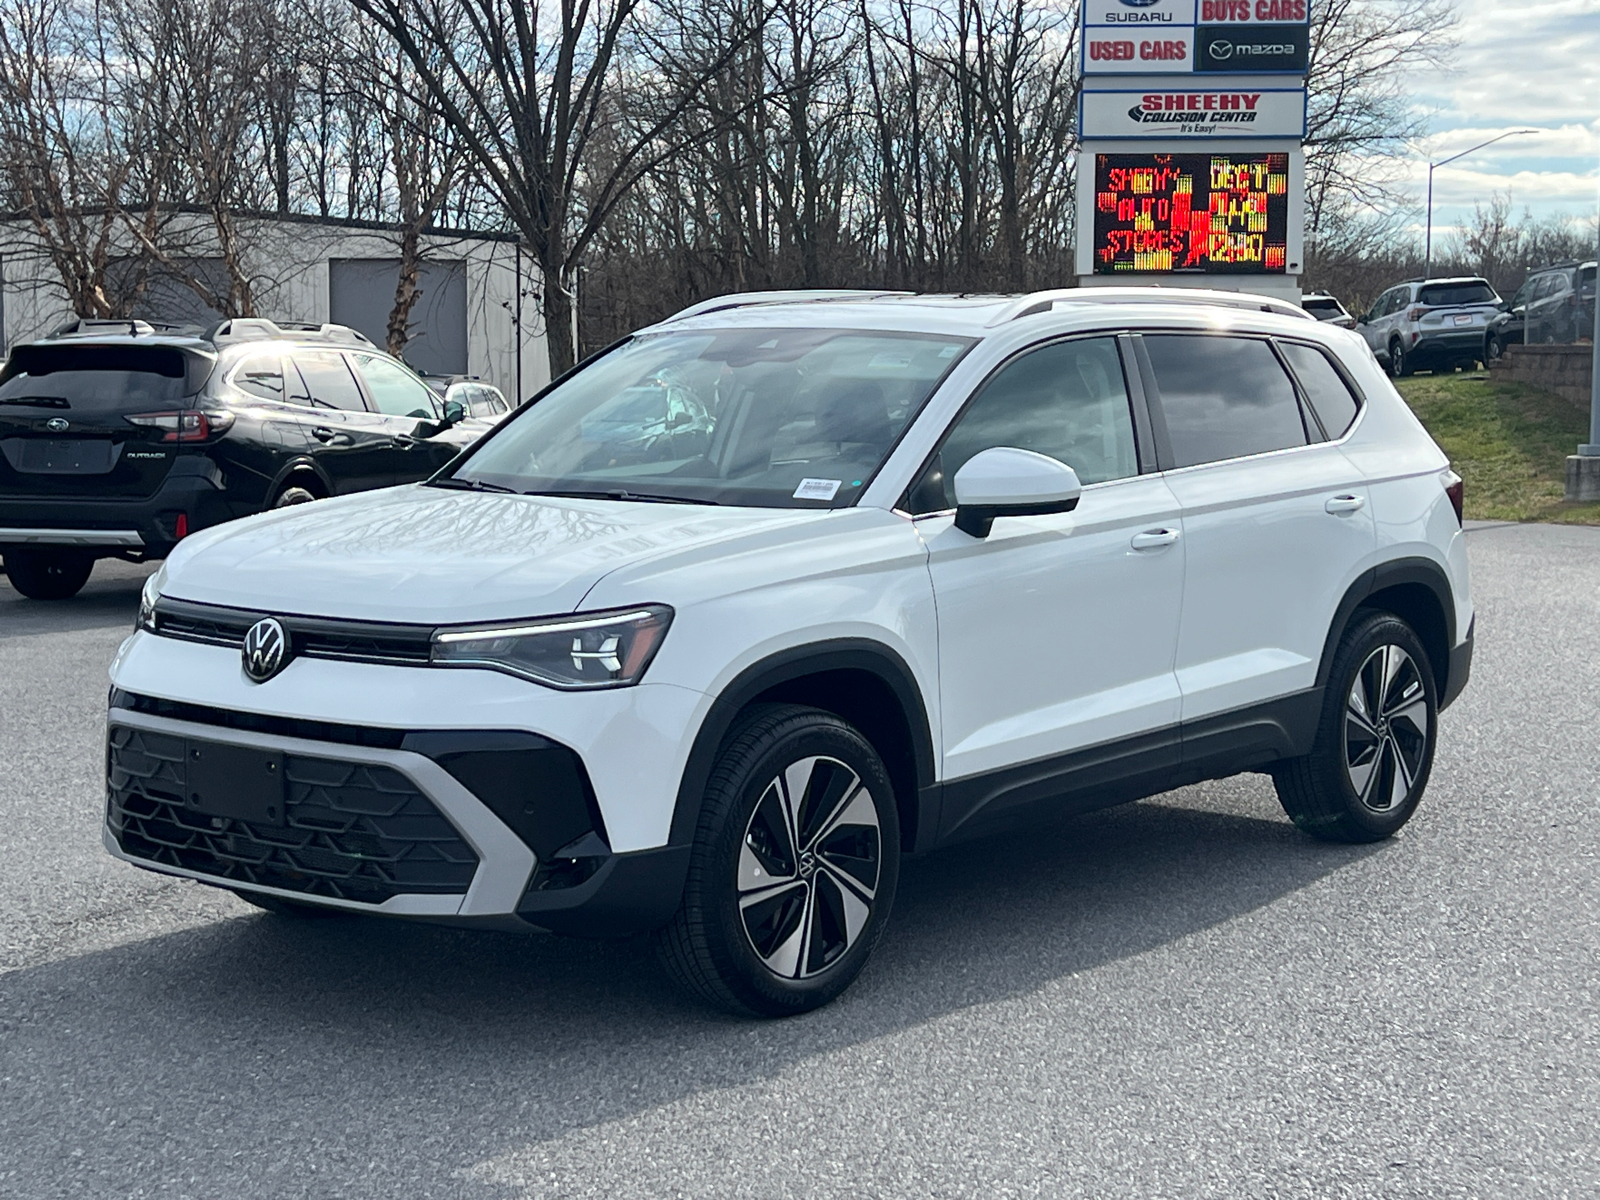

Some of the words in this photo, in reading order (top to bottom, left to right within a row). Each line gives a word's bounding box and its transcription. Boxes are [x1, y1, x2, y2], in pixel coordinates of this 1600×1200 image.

[1105, 12, 1173, 22] SUBARU
[1201, 0, 1250, 21] BUYS
[1255, 0, 1306, 21] CARS
[1089, 41, 1135, 61] USED
[1139, 40, 1187, 61] CARS
[1142, 94, 1261, 110] SHEEHY
[1142, 111, 1208, 123] COLLISION
[1209, 111, 1258, 123] CENTER
